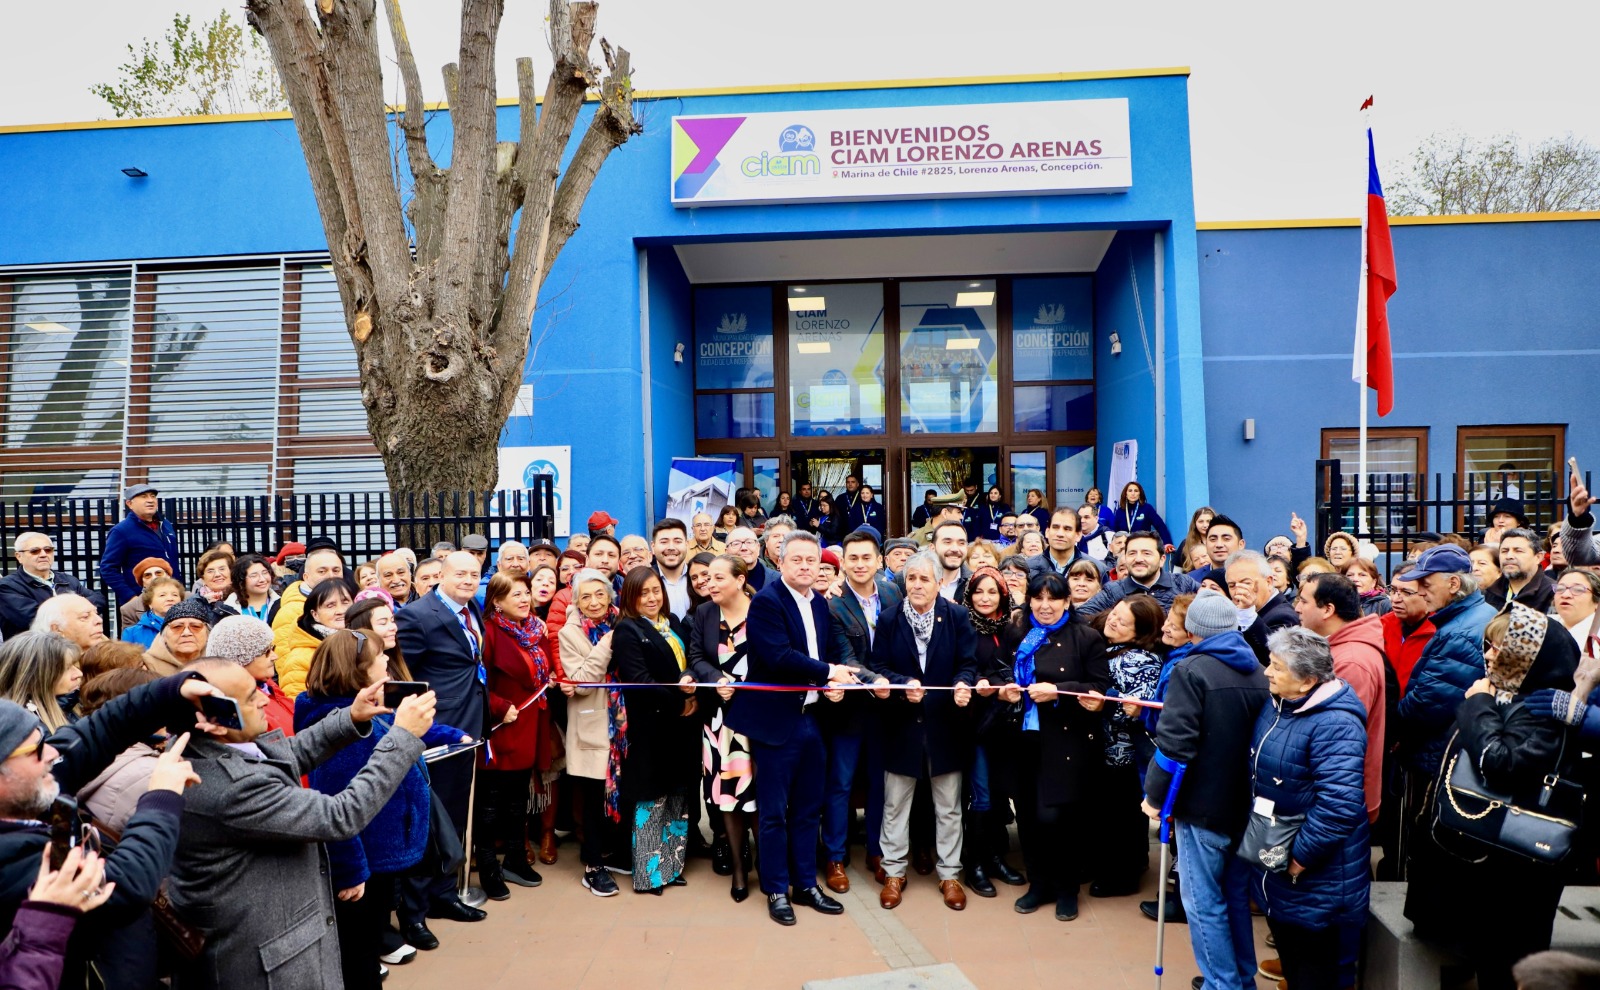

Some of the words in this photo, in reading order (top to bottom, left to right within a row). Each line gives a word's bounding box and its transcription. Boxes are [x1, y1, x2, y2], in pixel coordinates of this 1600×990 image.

[830, 124, 990, 146] BIENVENIDOS
[831, 147, 889, 165] CIAM
[897, 143, 1004, 162] LORENZO
[1009, 139, 1103, 159] ARENAS
[740, 150, 821, 178] ciam
[841, 170, 875, 179] Marina
[879, 169, 890, 178] de
[893, 168, 918, 178] Chile
[921, 166, 956, 177] #2825,
[958, 165, 998, 175] Lorenzo
[1001, 164, 1038, 174] Arenas,
[1040, 161, 1103, 173] Concepción.
[796, 309, 827, 319] CIAM
[795, 318, 850, 331] LORENZO
[797, 331, 842, 342] ARENAS
[1016, 329, 1090, 348] CONCEPCIÓN
